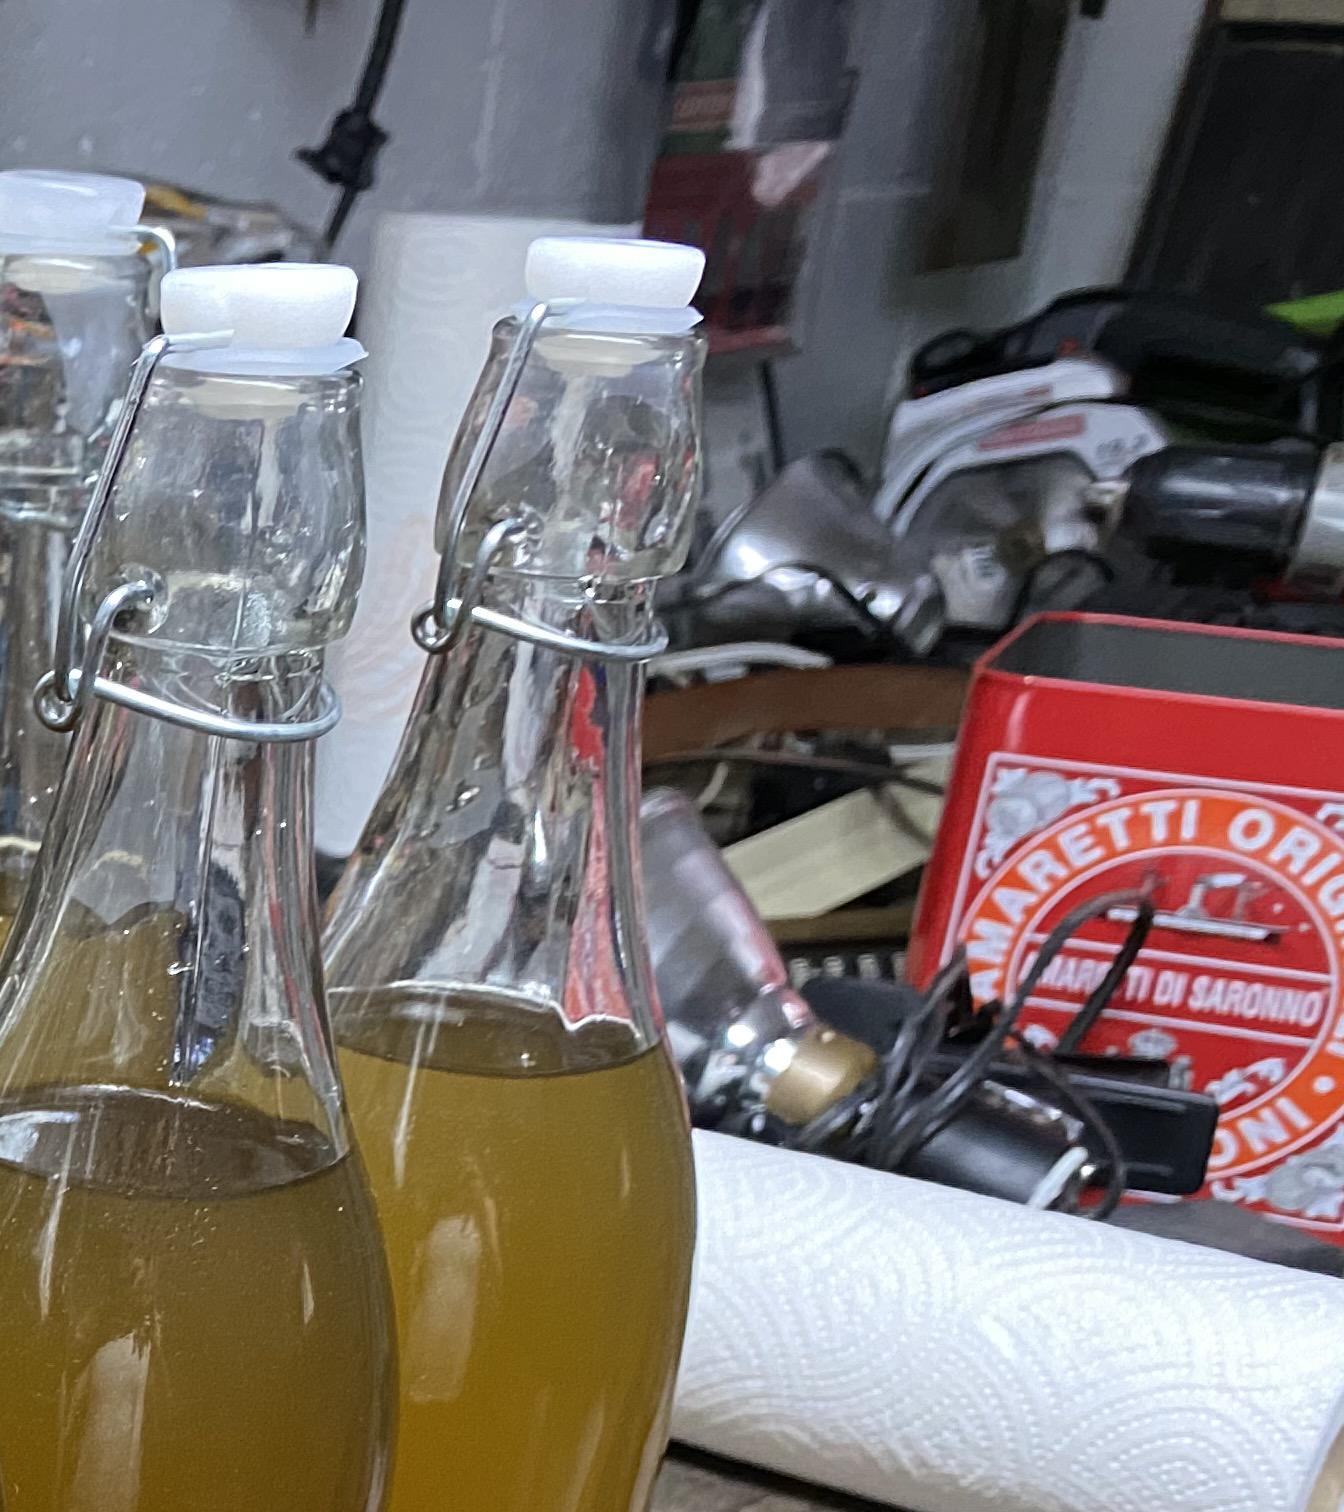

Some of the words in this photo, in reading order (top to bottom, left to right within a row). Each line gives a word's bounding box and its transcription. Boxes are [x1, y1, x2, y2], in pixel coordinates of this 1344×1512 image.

[967, 799, 1200, 1001] AMARETTI
[1153, 969, 1188, 1008] DI
[1188, 974, 1323, 1027] SARONNO
